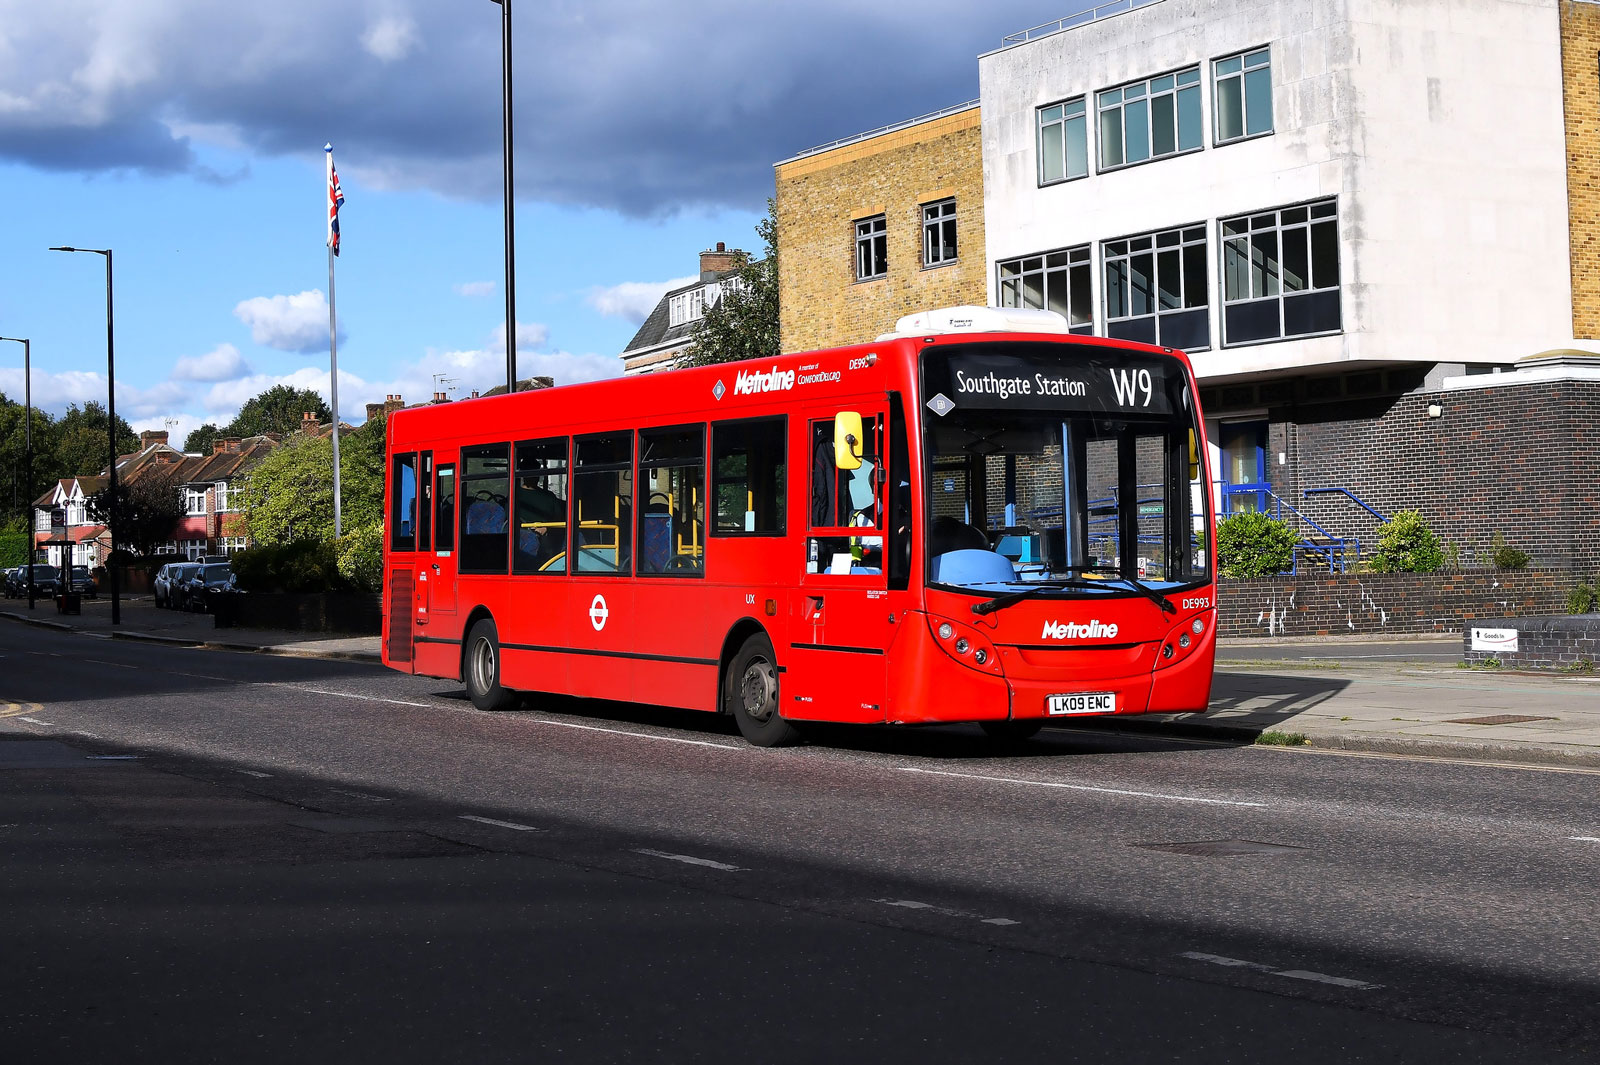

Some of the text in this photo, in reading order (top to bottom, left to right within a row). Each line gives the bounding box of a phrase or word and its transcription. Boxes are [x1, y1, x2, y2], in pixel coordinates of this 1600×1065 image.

[733, 365, 795, 395] Metroline
[956, 370, 1086, 399] Southgate Station
[1109, 368, 1152, 407] W9
[745, 593, 755, 604] UX
[1182, 597, 1210, 609] DE993
[1041, 619, 1119, 639] Metroline
[1054, 696, 1110, 711] LK09 ENC
